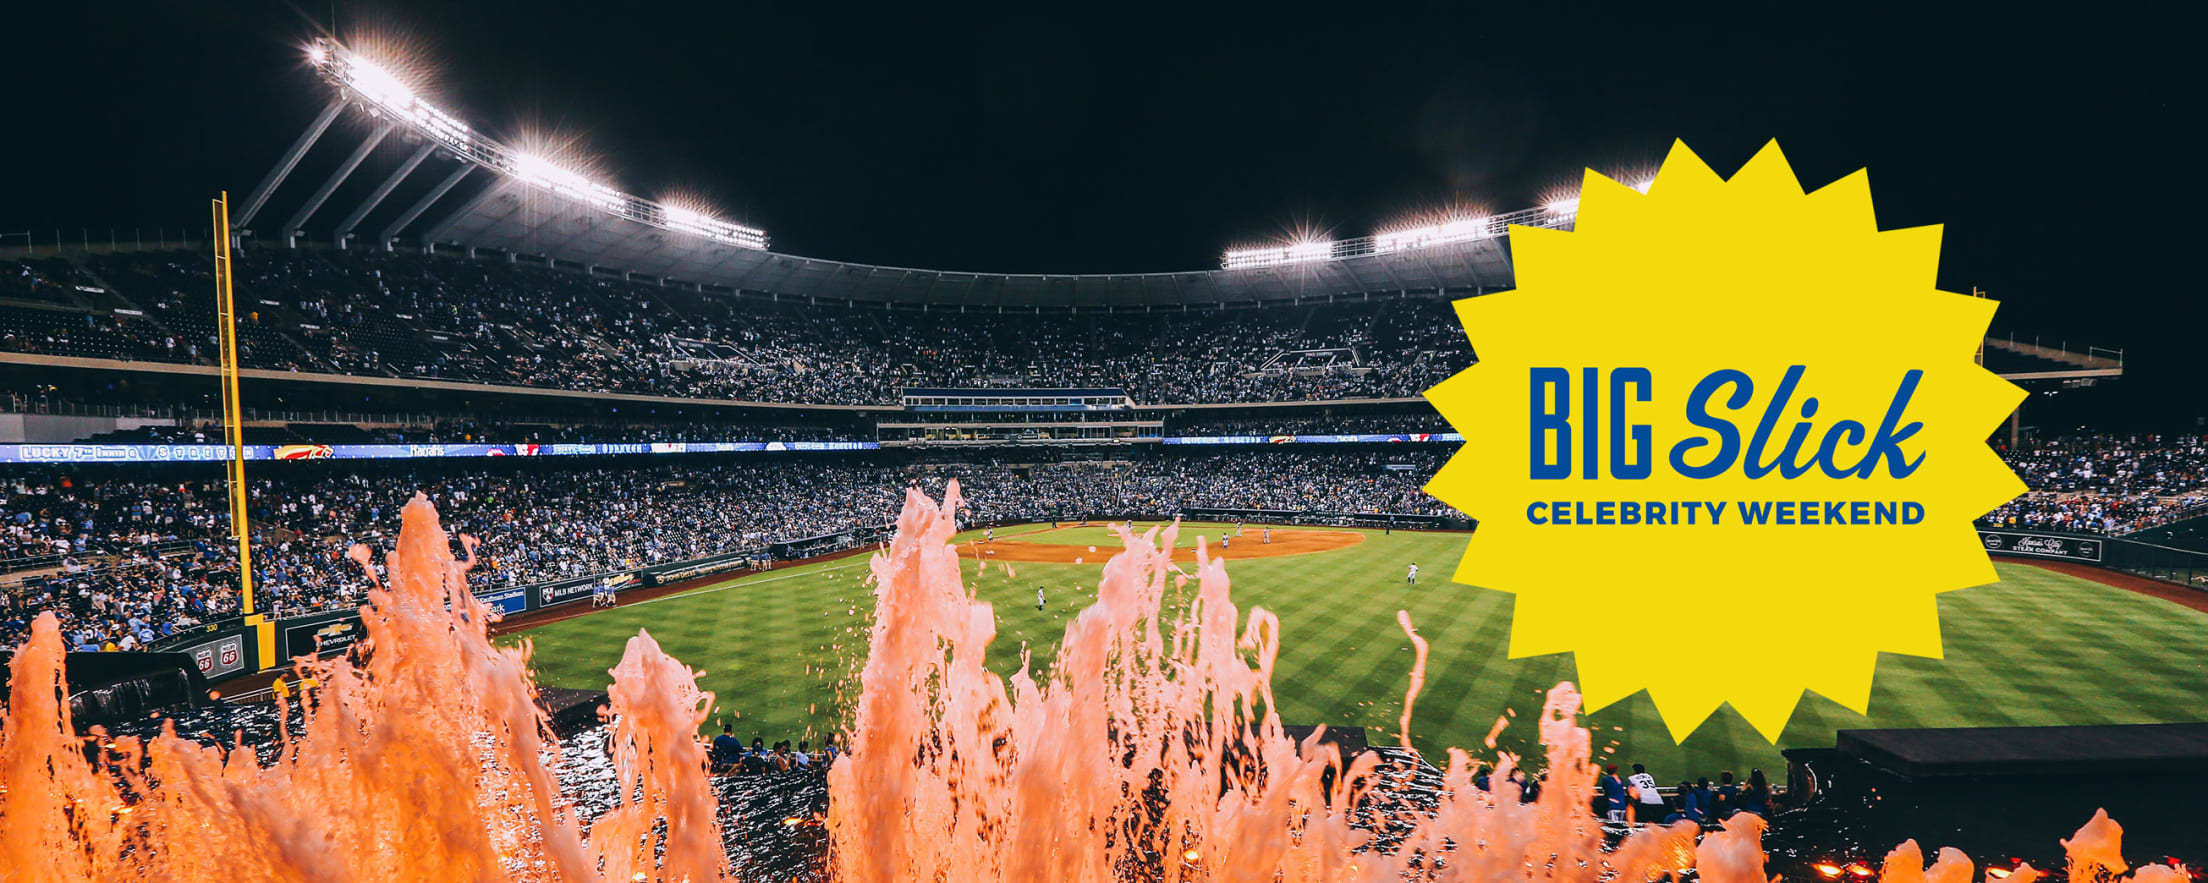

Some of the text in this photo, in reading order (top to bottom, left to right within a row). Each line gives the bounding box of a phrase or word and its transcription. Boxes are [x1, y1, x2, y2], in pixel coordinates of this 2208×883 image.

[22, 446, 70, 459] LUCKY
[555, 582, 594, 597] MLB NETWORK
[223, 651, 236, 663] 66
[199, 659, 211, 670] 66
[1640, 779, 1656, 789] 35
